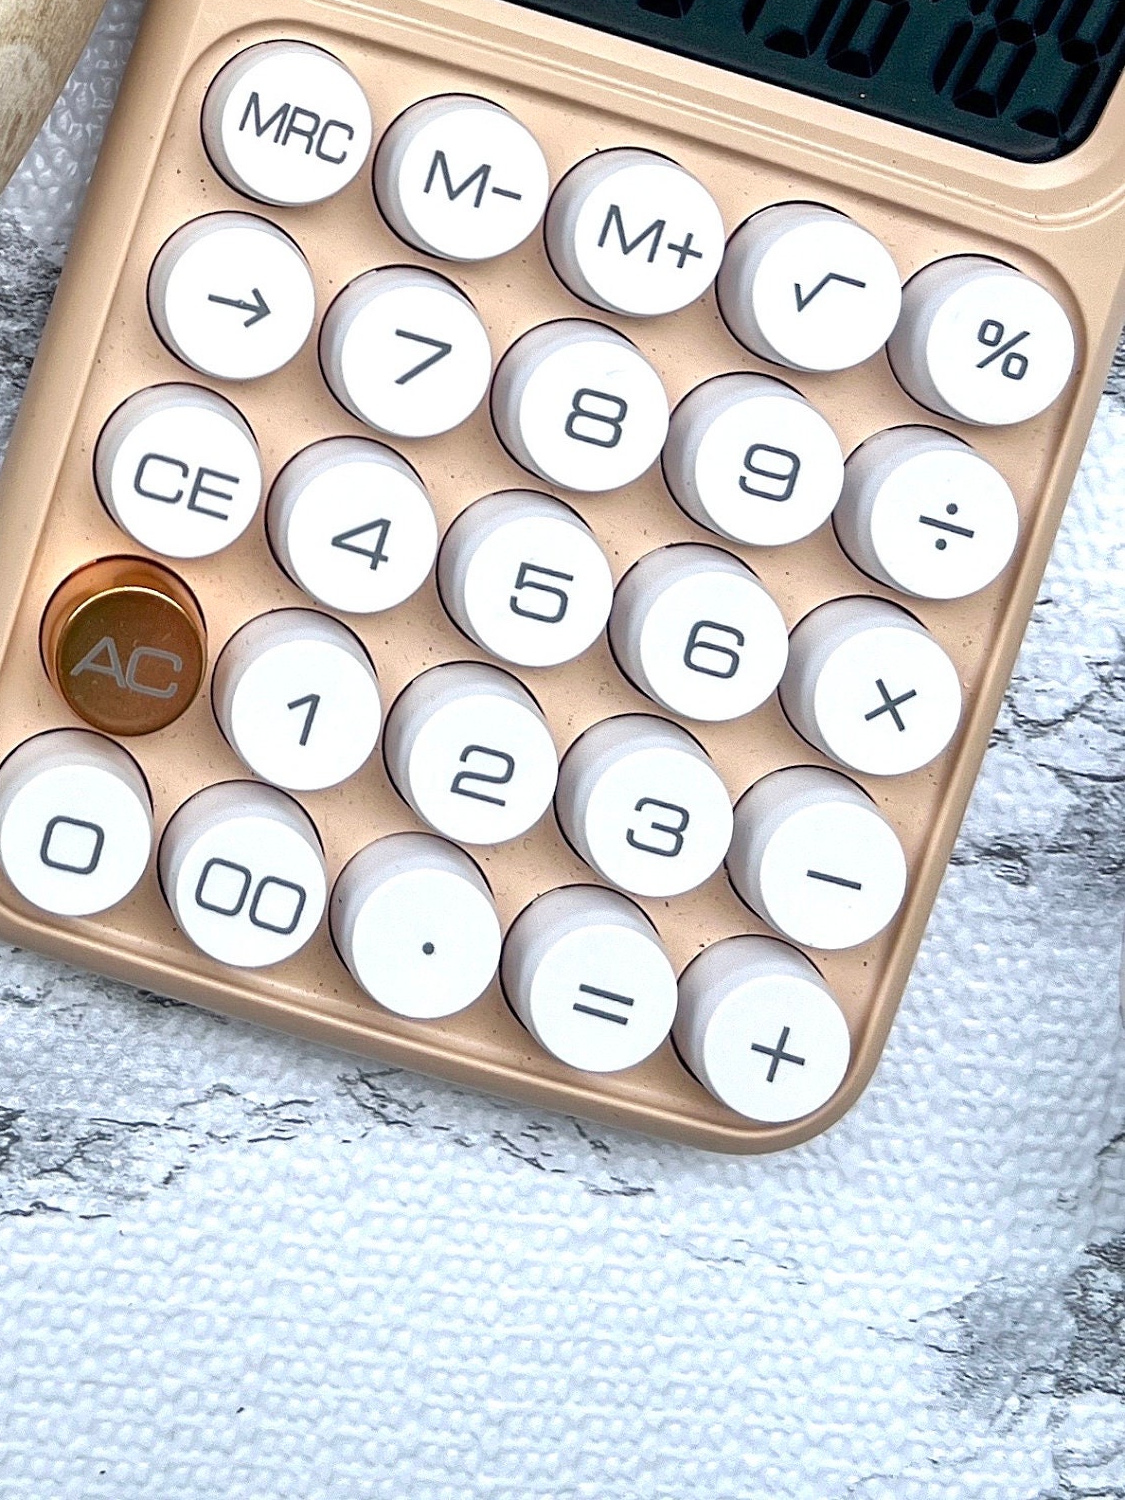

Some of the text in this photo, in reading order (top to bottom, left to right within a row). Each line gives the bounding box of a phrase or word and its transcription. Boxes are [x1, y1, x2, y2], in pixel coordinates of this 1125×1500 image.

[239, 92, 354, 164] MRC
[424, 150, 521, 208] M-
[598, 205, 702, 268] M+
[396, 330, 452, 384] 7
[977, 320, 1030, 380] %
[565, 389, 627, 448] 8
[134, 454, 239, 520] CE
[739, 444, 800, 502] 9
[332, 519, 391, 570] 4
[510, 563, 573, 623] 5
[71, 636, 182, 699] AC
[684, 621, 744, 678] 6
[288, 694, 320, 746] 1
[451, 745, 514, 806] 2
[40, 816, 104, 874] 0
[626, 798, 689, 857] 3
[195, 858, 306, 935] 00
